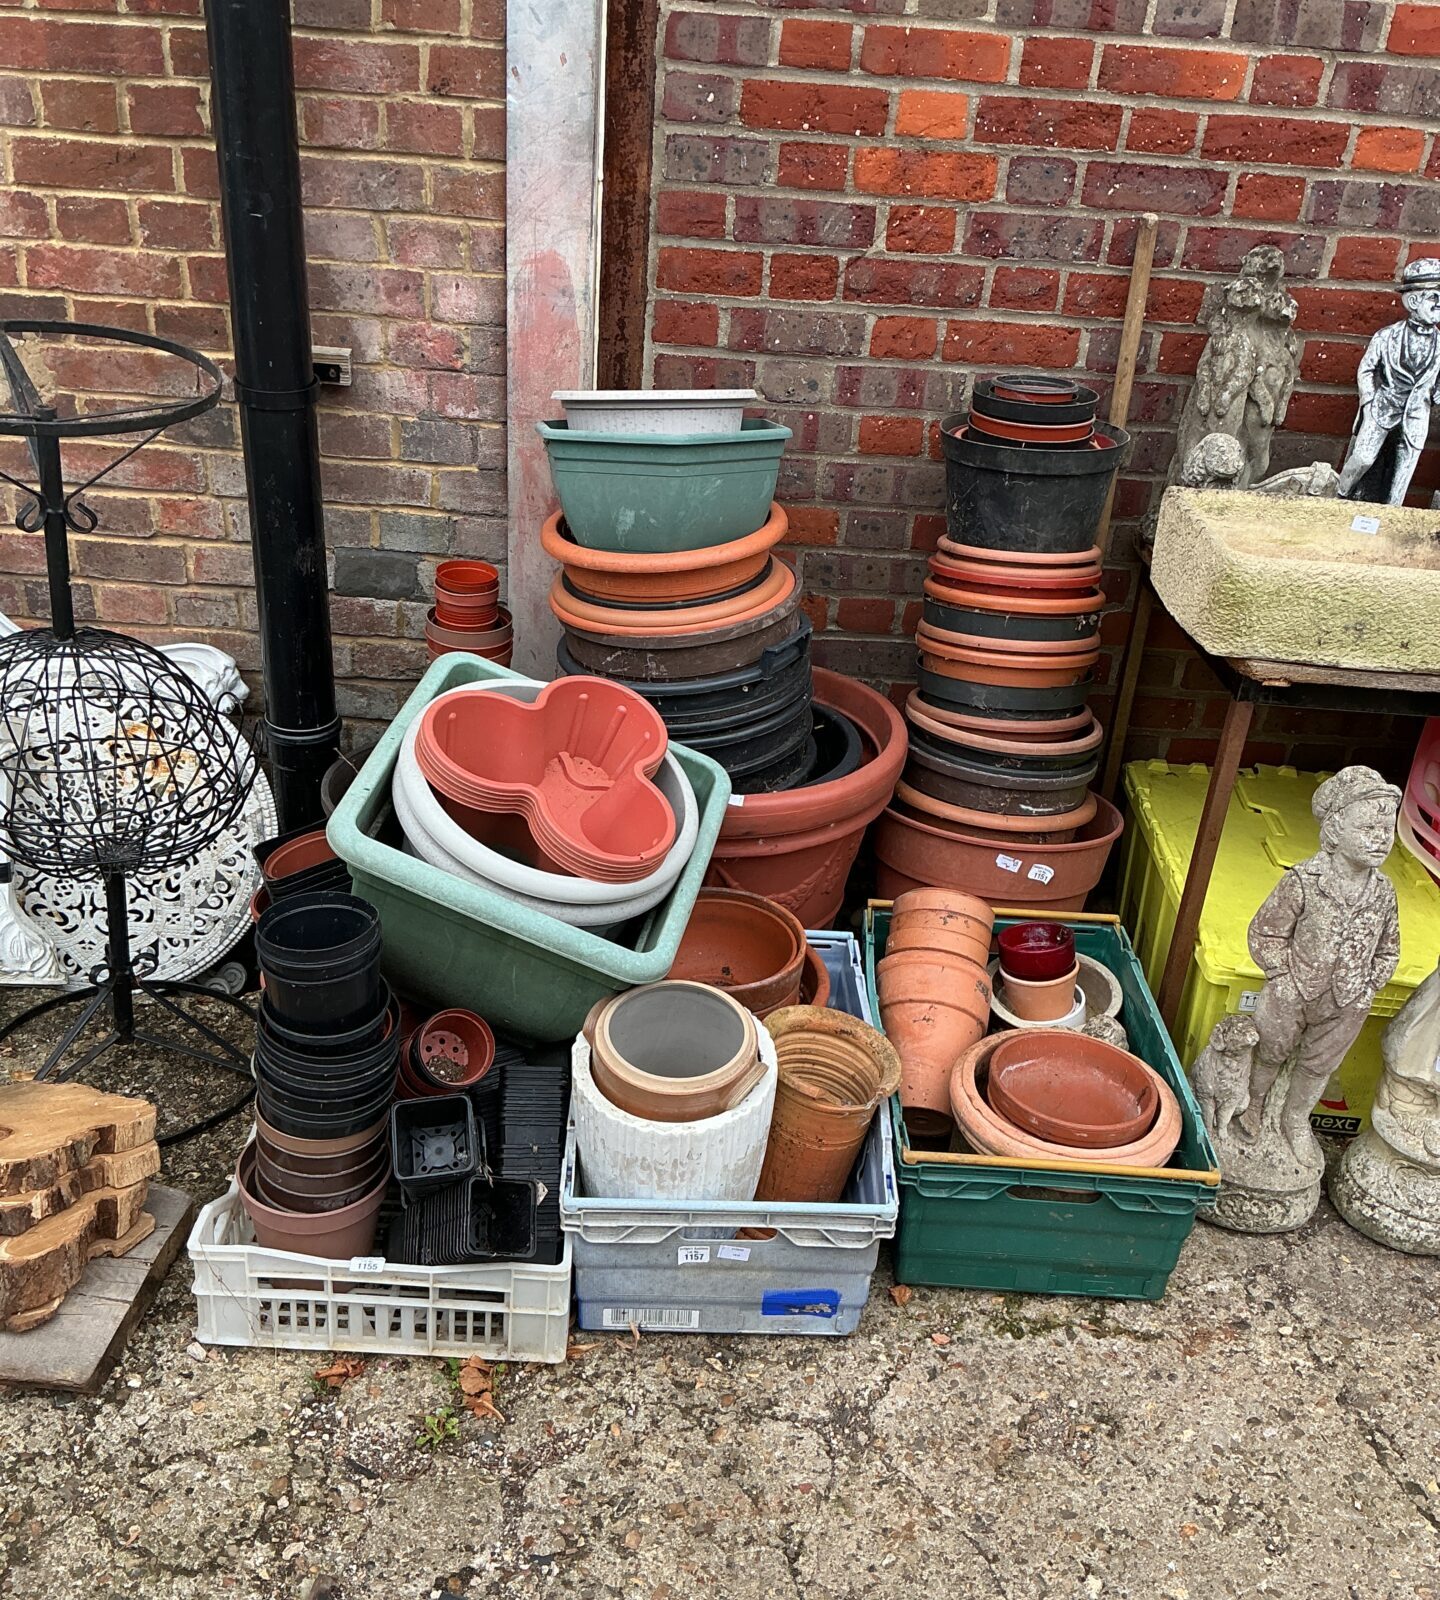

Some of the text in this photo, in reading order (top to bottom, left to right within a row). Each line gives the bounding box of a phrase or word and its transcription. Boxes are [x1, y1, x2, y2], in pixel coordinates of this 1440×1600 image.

[1034, 872, 1048, 882] 1151
[1310, 1116, 1357, 1130] next
[685, 1253, 704, 1261] 1157
